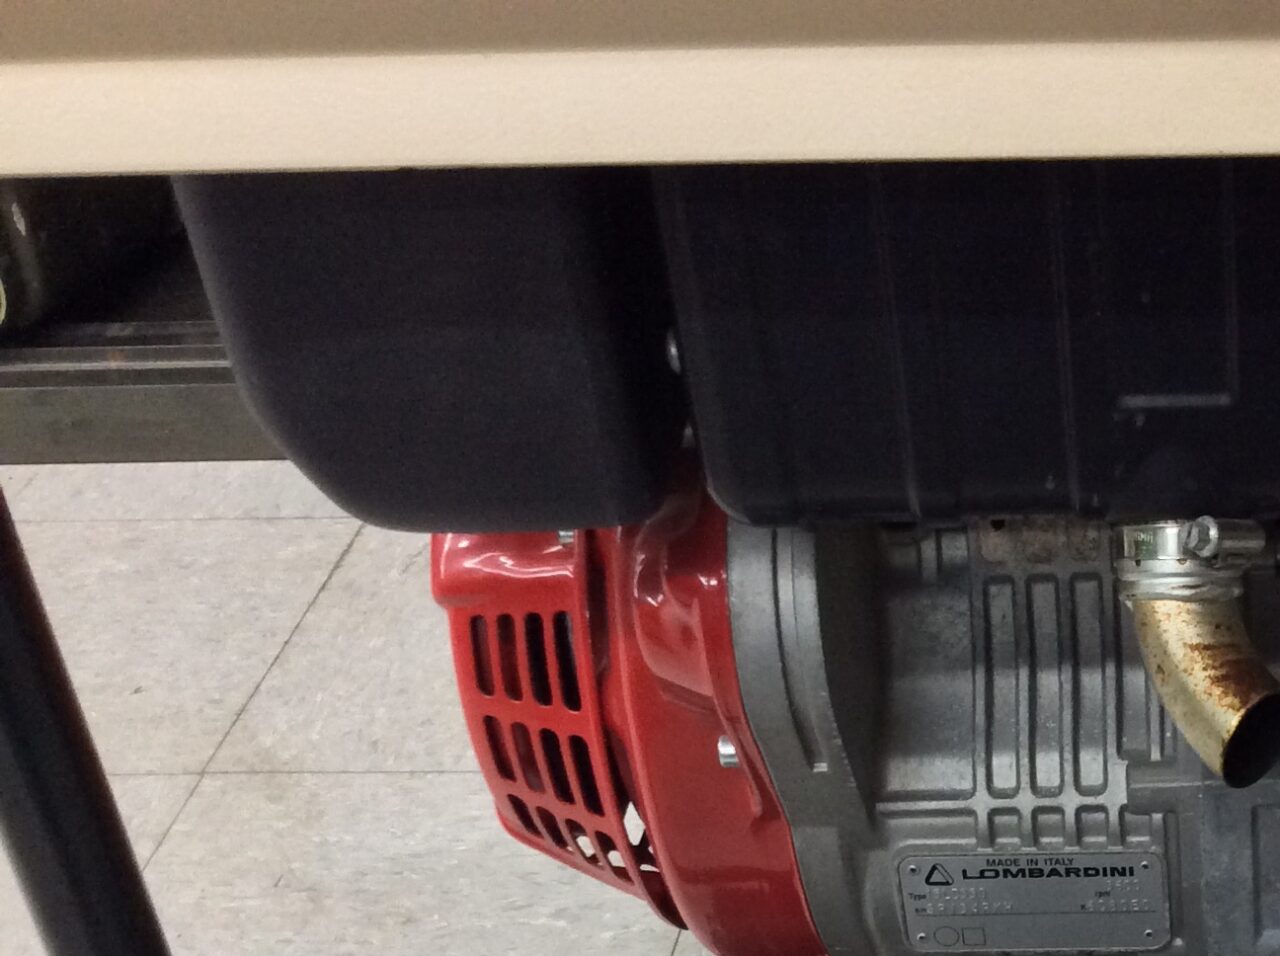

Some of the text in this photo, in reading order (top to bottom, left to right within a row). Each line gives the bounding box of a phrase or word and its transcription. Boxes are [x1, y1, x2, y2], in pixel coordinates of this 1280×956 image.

[986, 856, 1074, 867] MADE IN ITALY
[961, 865, 1135, 881] LOMBARDINI
